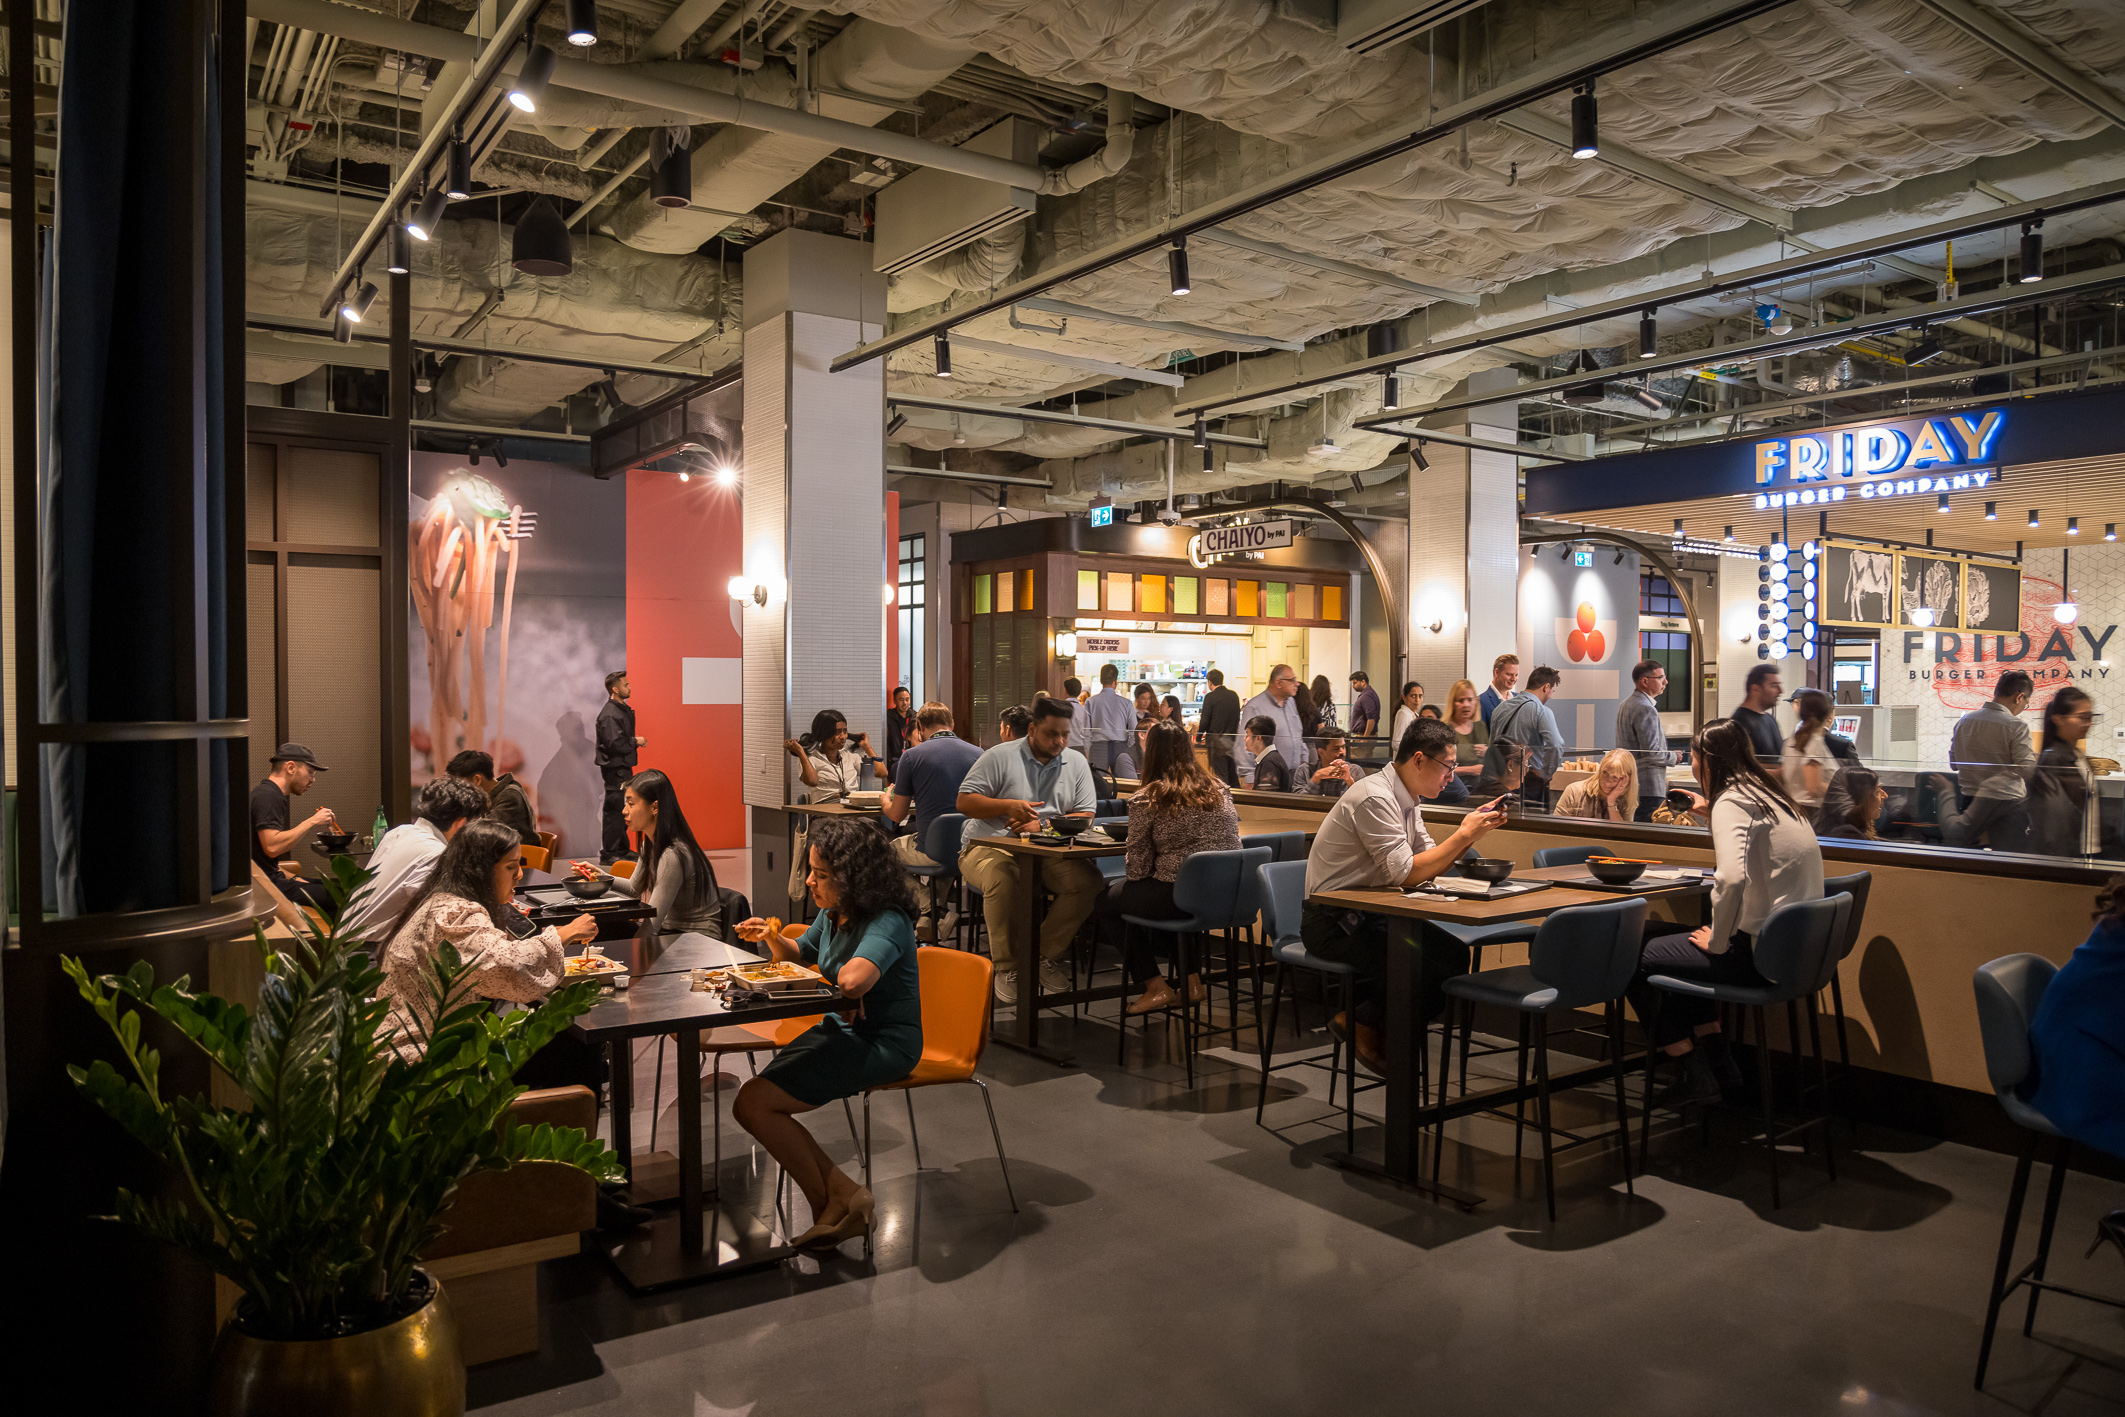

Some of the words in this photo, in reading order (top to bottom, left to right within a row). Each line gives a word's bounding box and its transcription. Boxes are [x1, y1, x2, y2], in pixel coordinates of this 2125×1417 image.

[1755, 411, 2001, 486] FRIDAY
[1755, 486, 1847, 509] BURGER
[1860, 471, 1990, 498] COMPANY
[1206, 525, 1266, 551] CHAIYO
[1267, 531, 1274, 539] by
[1903, 625, 2119, 663] FRIDAY
[1909, 669, 1986, 680] BURGER
